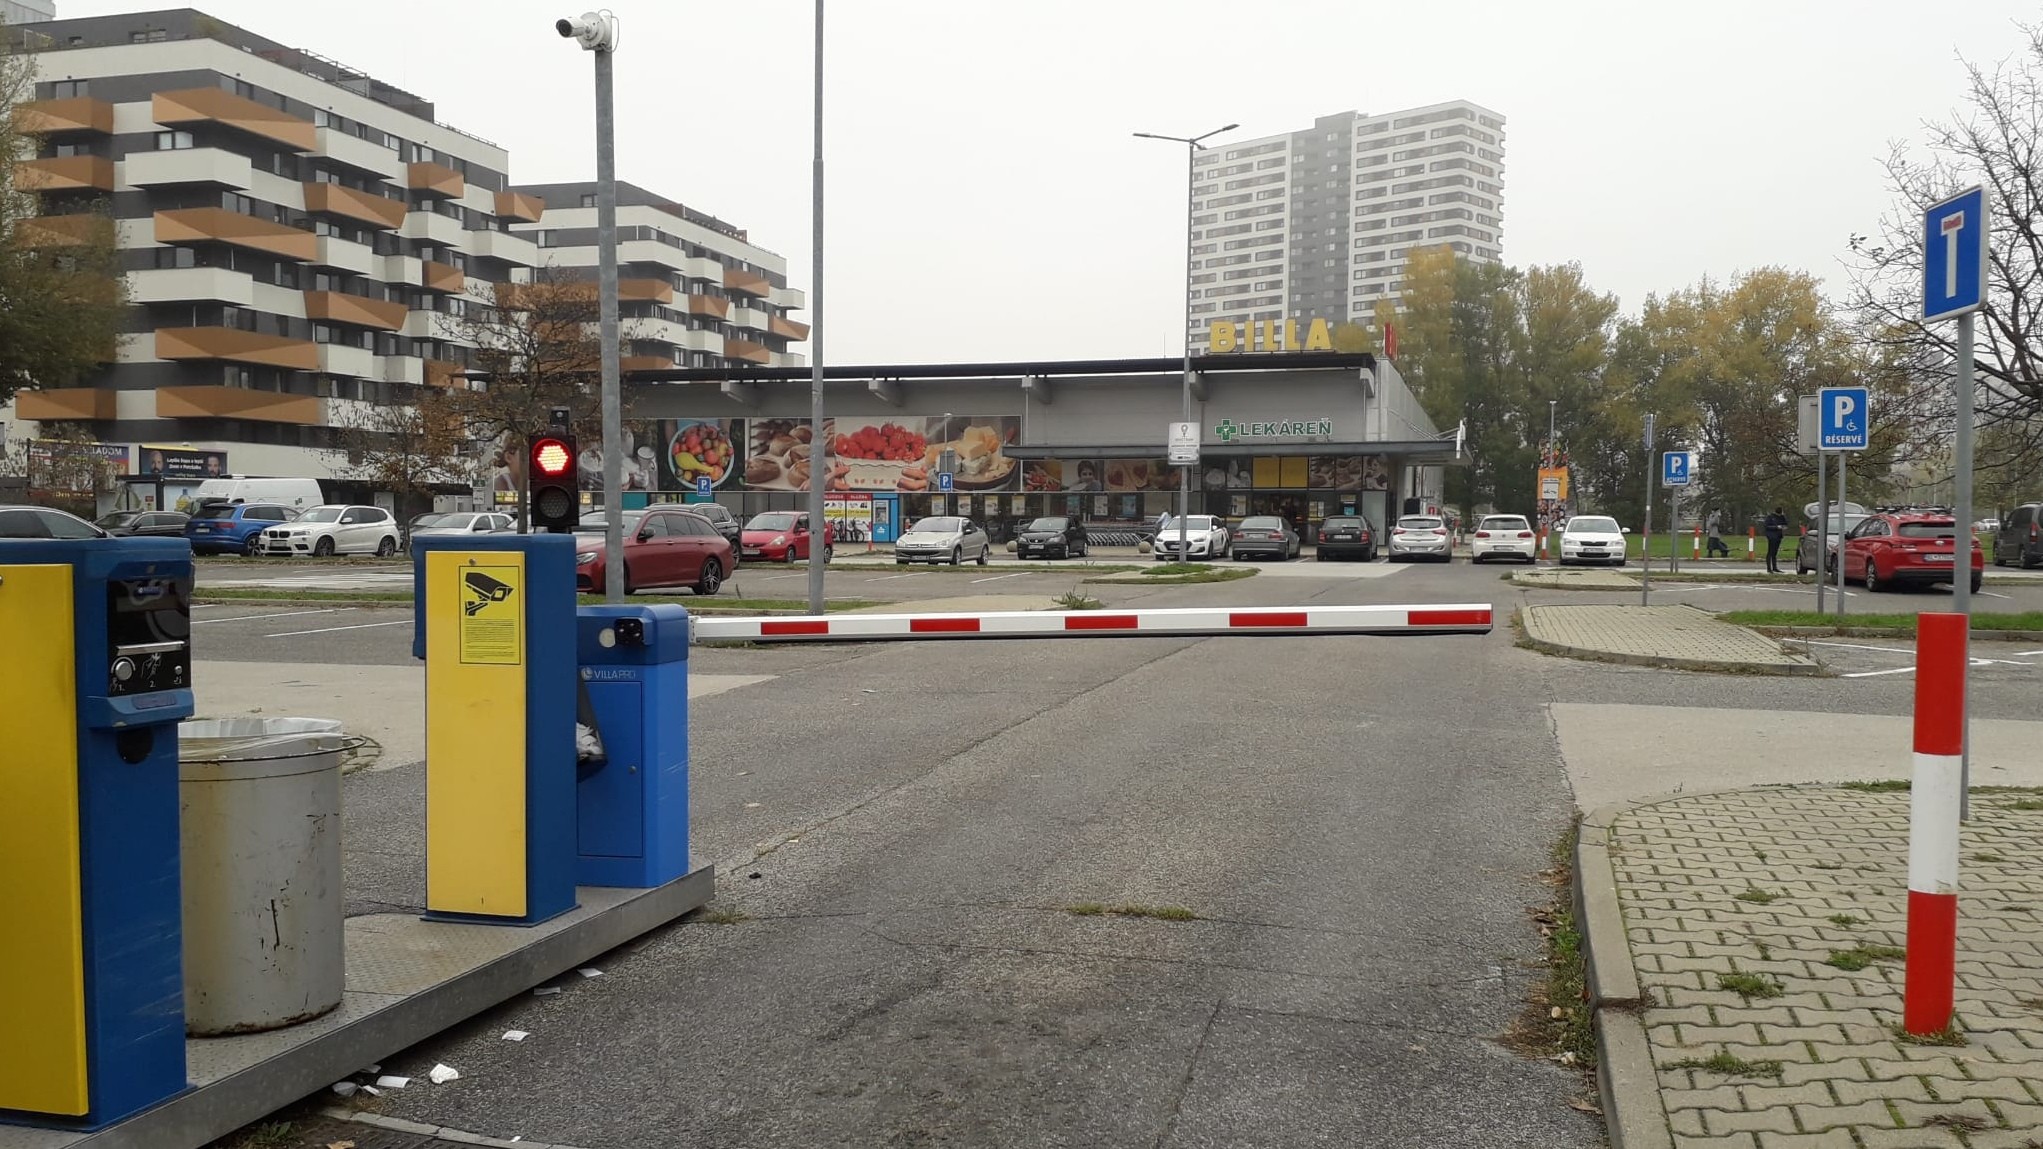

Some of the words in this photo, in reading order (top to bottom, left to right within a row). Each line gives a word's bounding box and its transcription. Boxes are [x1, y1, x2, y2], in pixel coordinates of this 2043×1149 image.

[1210, 317, 1333, 353] BILLA
[1834, 396, 1855, 428] P
[1240, 417, 1333, 437] LEKÁREŇ
[1825, 434, 1862, 444] RÉSERVÉ
[1671, 456, 1683, 474] P
[701, 480, 708, 490] P
